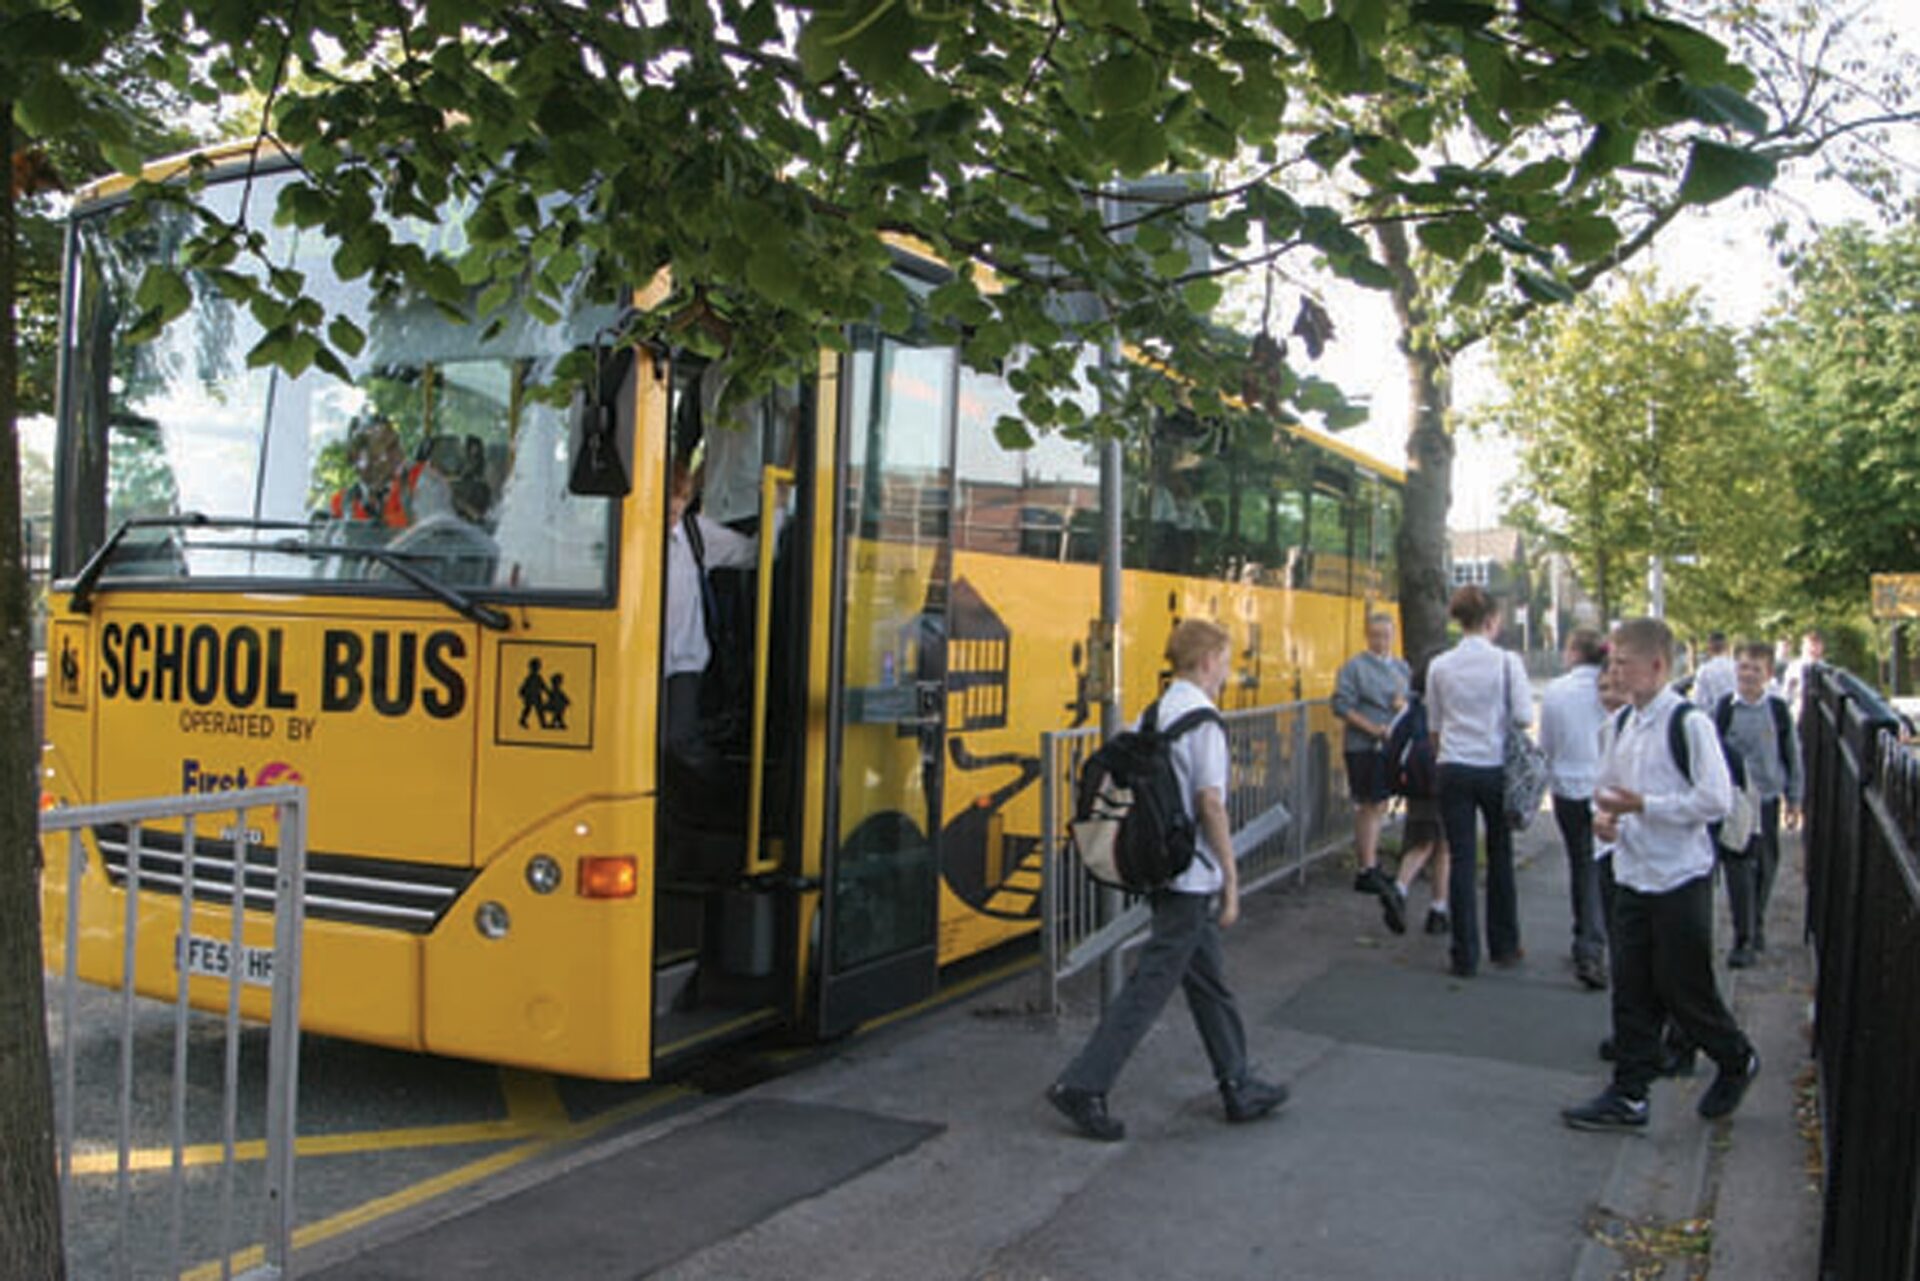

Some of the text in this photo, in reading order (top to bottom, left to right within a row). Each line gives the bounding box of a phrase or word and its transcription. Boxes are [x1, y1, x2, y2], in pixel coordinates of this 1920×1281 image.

[101, 622, 467, 719] SCHOOL BUS
[180, 710, 316, 741] OPERATED BY
[188, 940, 243, 972] FE5
